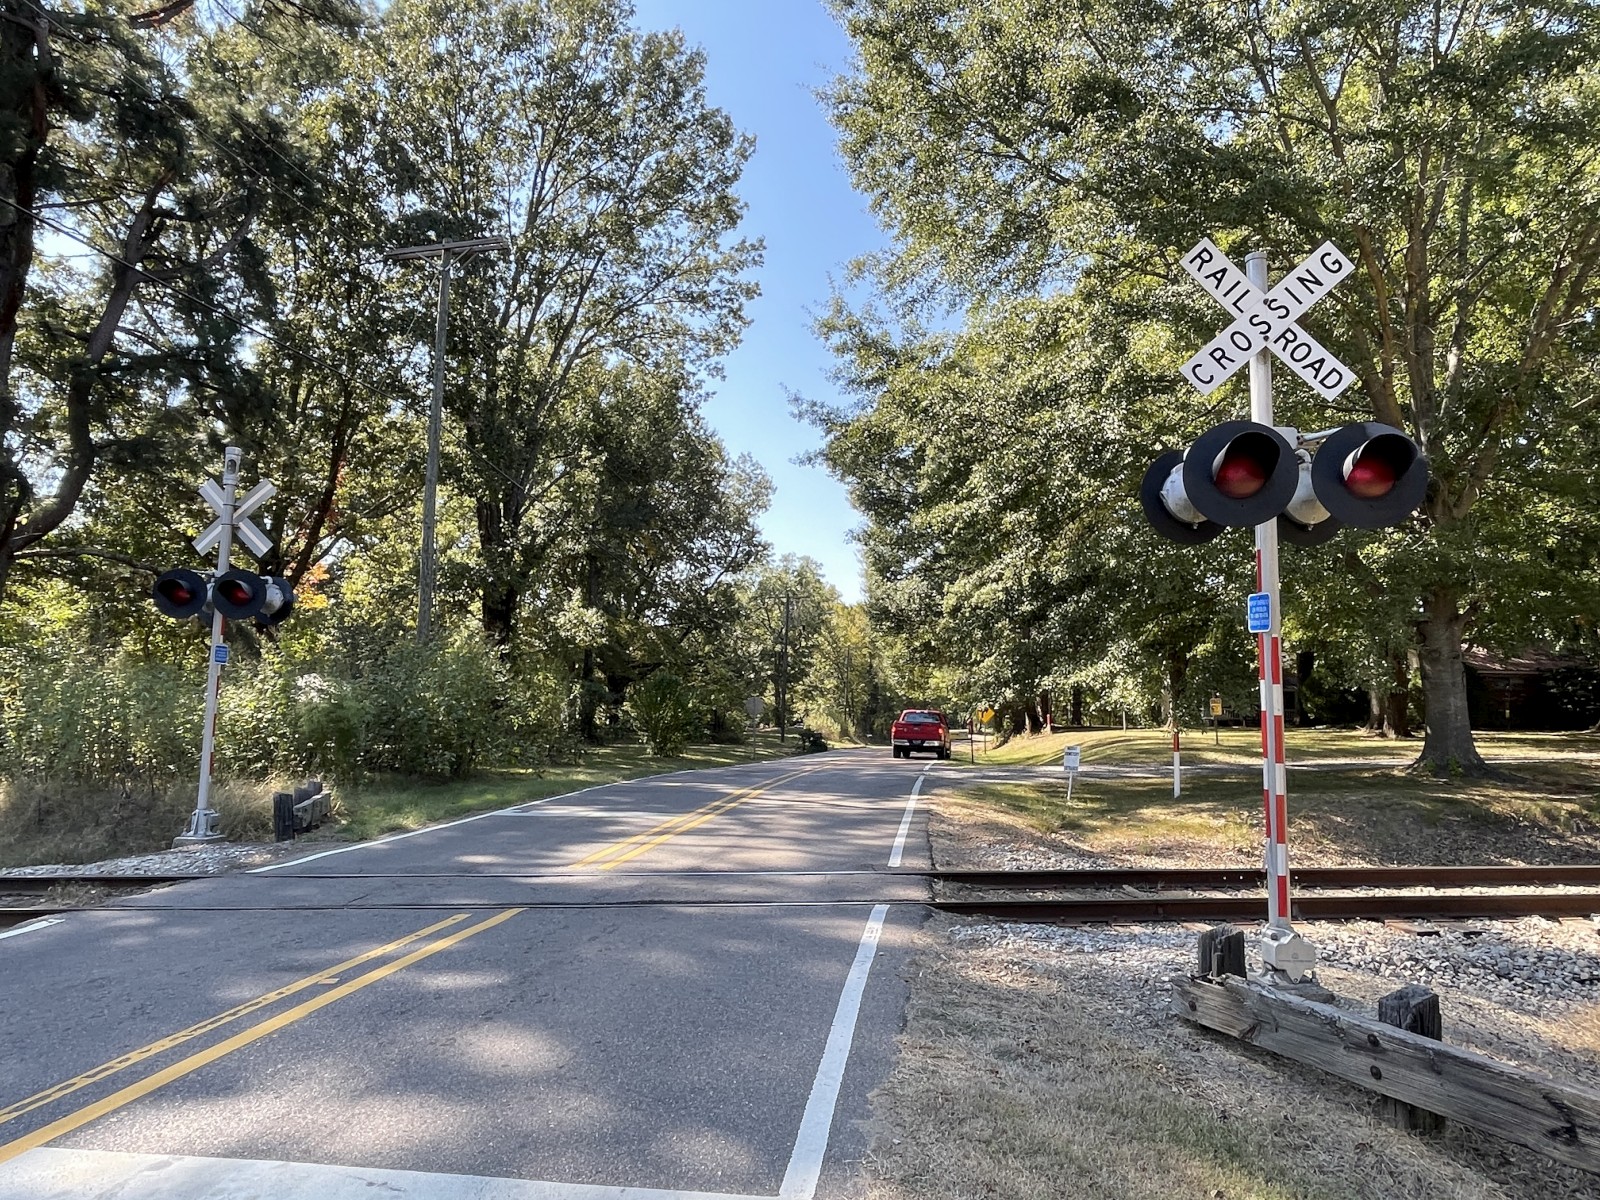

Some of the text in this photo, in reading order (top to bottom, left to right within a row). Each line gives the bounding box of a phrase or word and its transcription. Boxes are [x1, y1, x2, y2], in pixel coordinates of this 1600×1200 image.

[1188, 247, 1343, 389] RAIL ROAD
[1191, 252, 1343, 385] CROSSING
